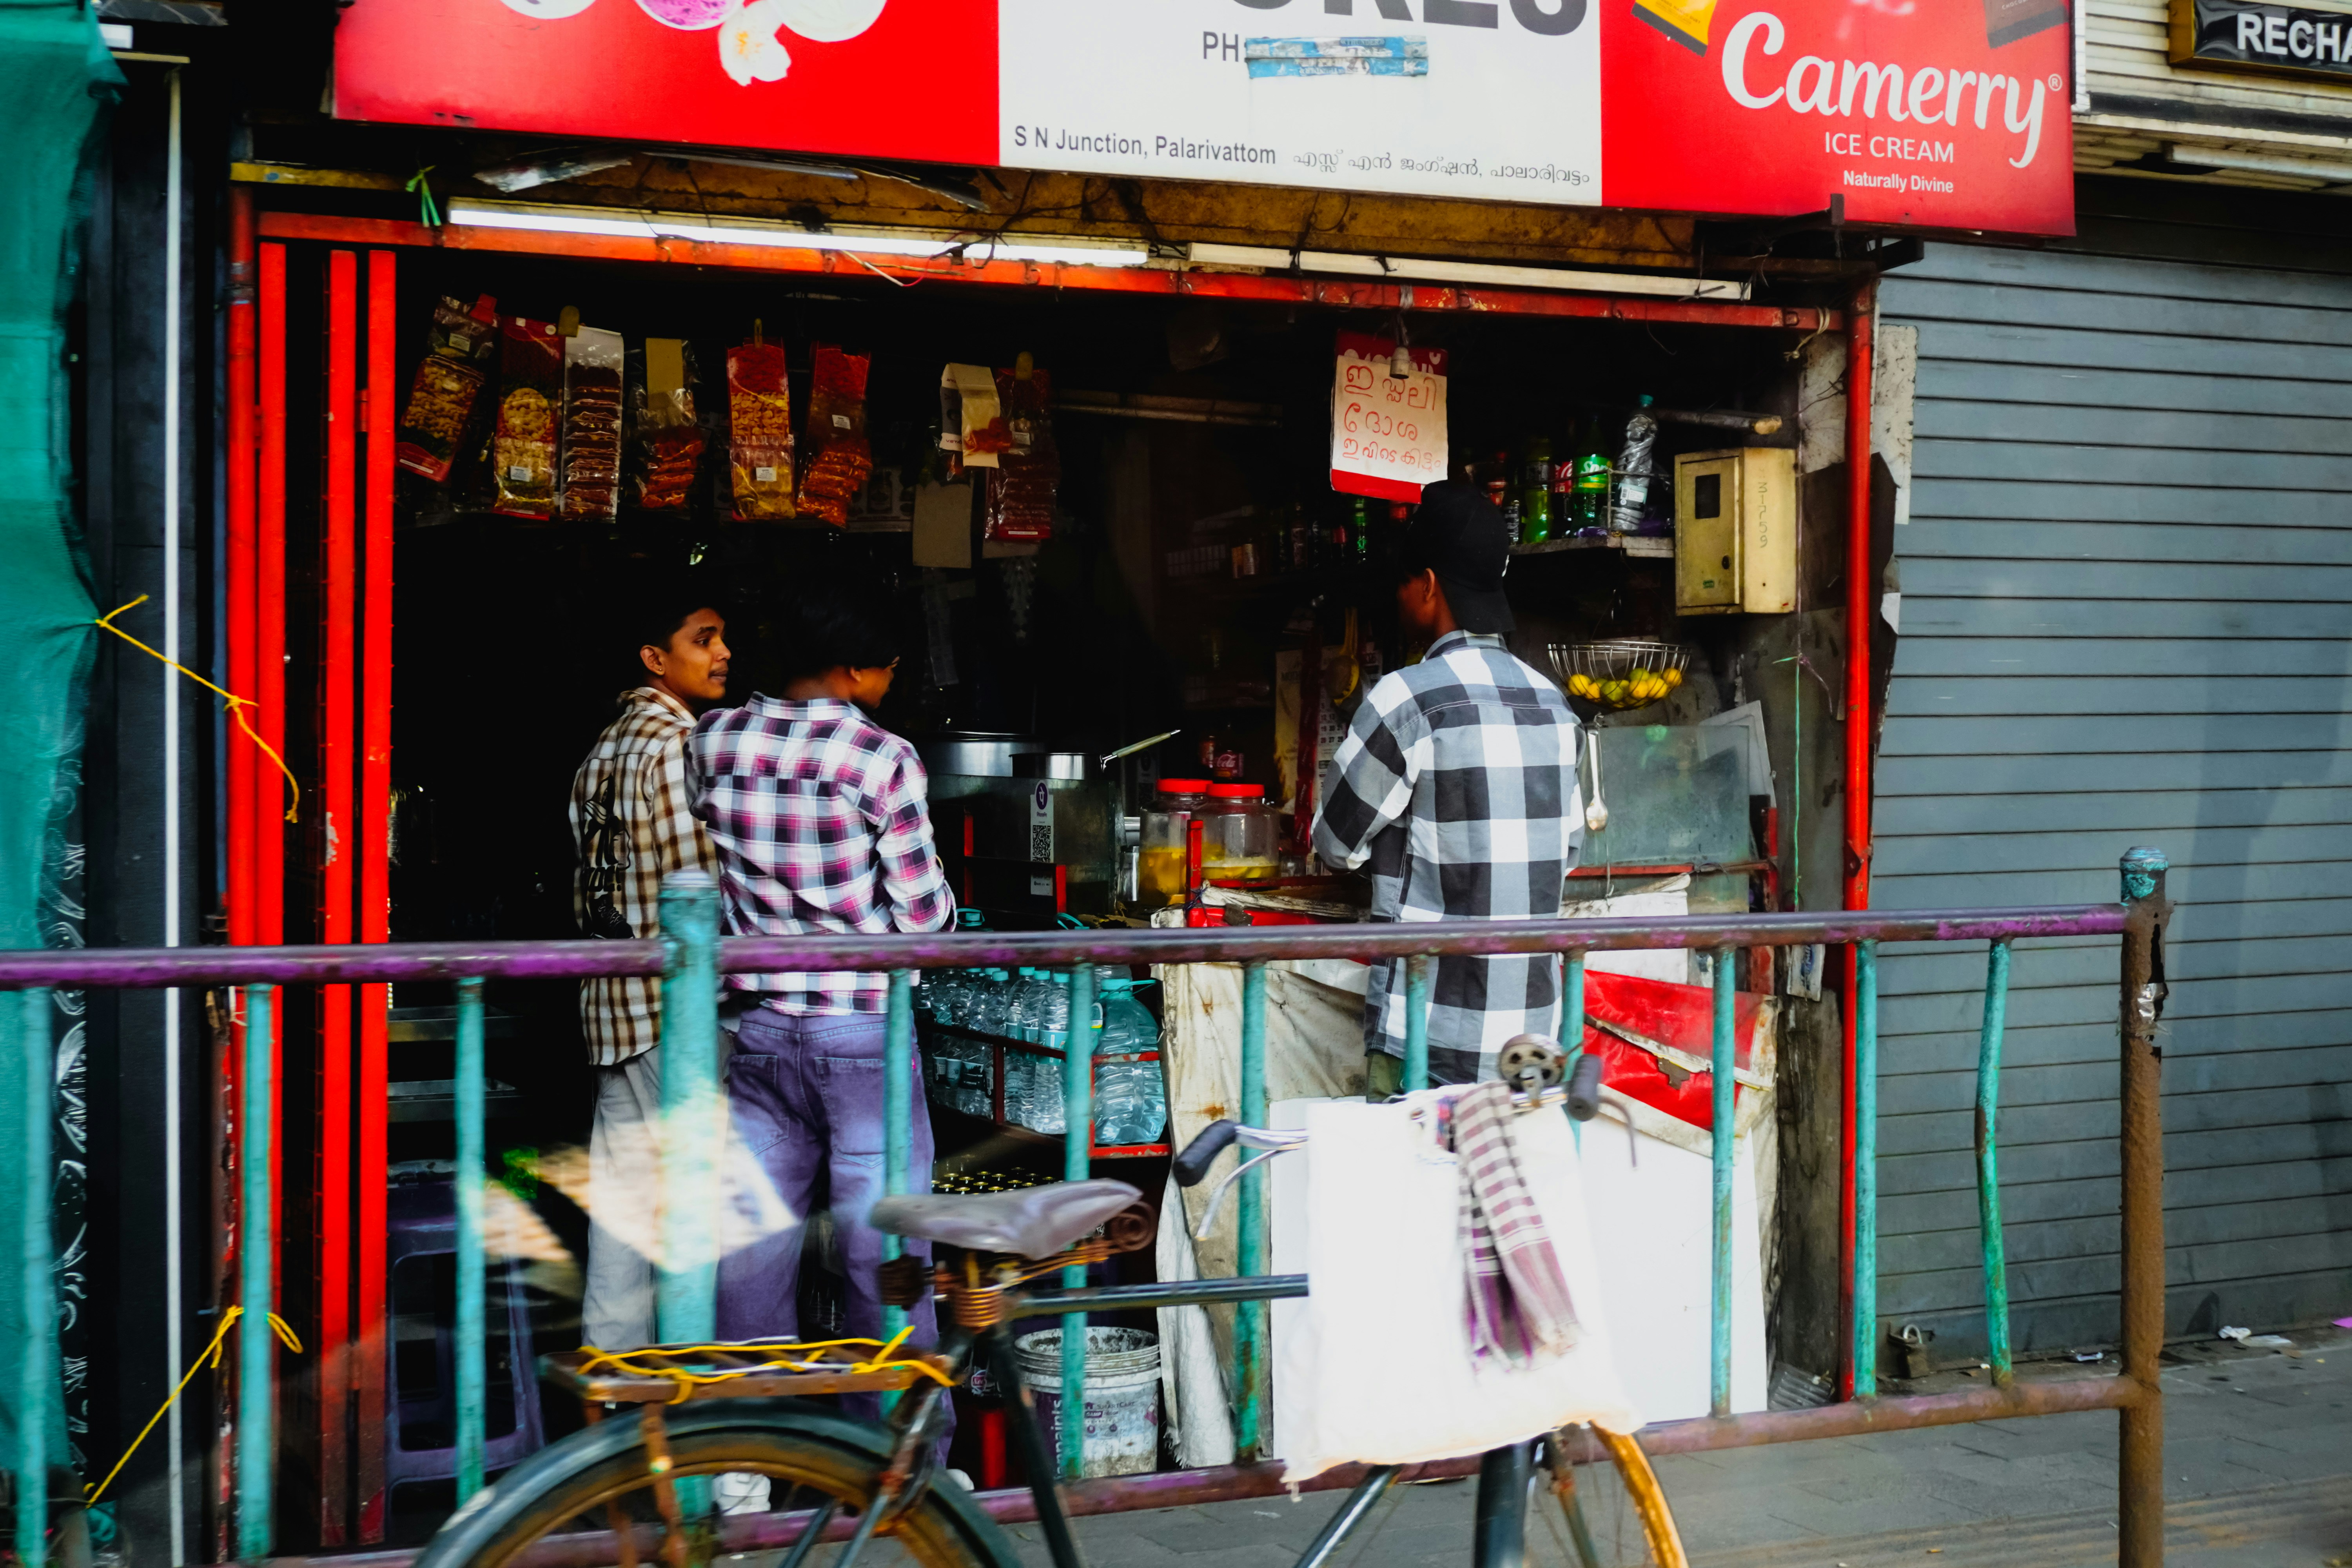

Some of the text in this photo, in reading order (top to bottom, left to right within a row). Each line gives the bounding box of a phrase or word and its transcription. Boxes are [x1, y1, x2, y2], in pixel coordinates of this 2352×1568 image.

[1722, 11, 2045, 168] Camerry
[1015, 125, 1276, 164] S N Junction, Palarivattom
[1825, 131, 1954, 163] ICE CREAM
[1844, 170, 1954, 193] Naturally Divine
